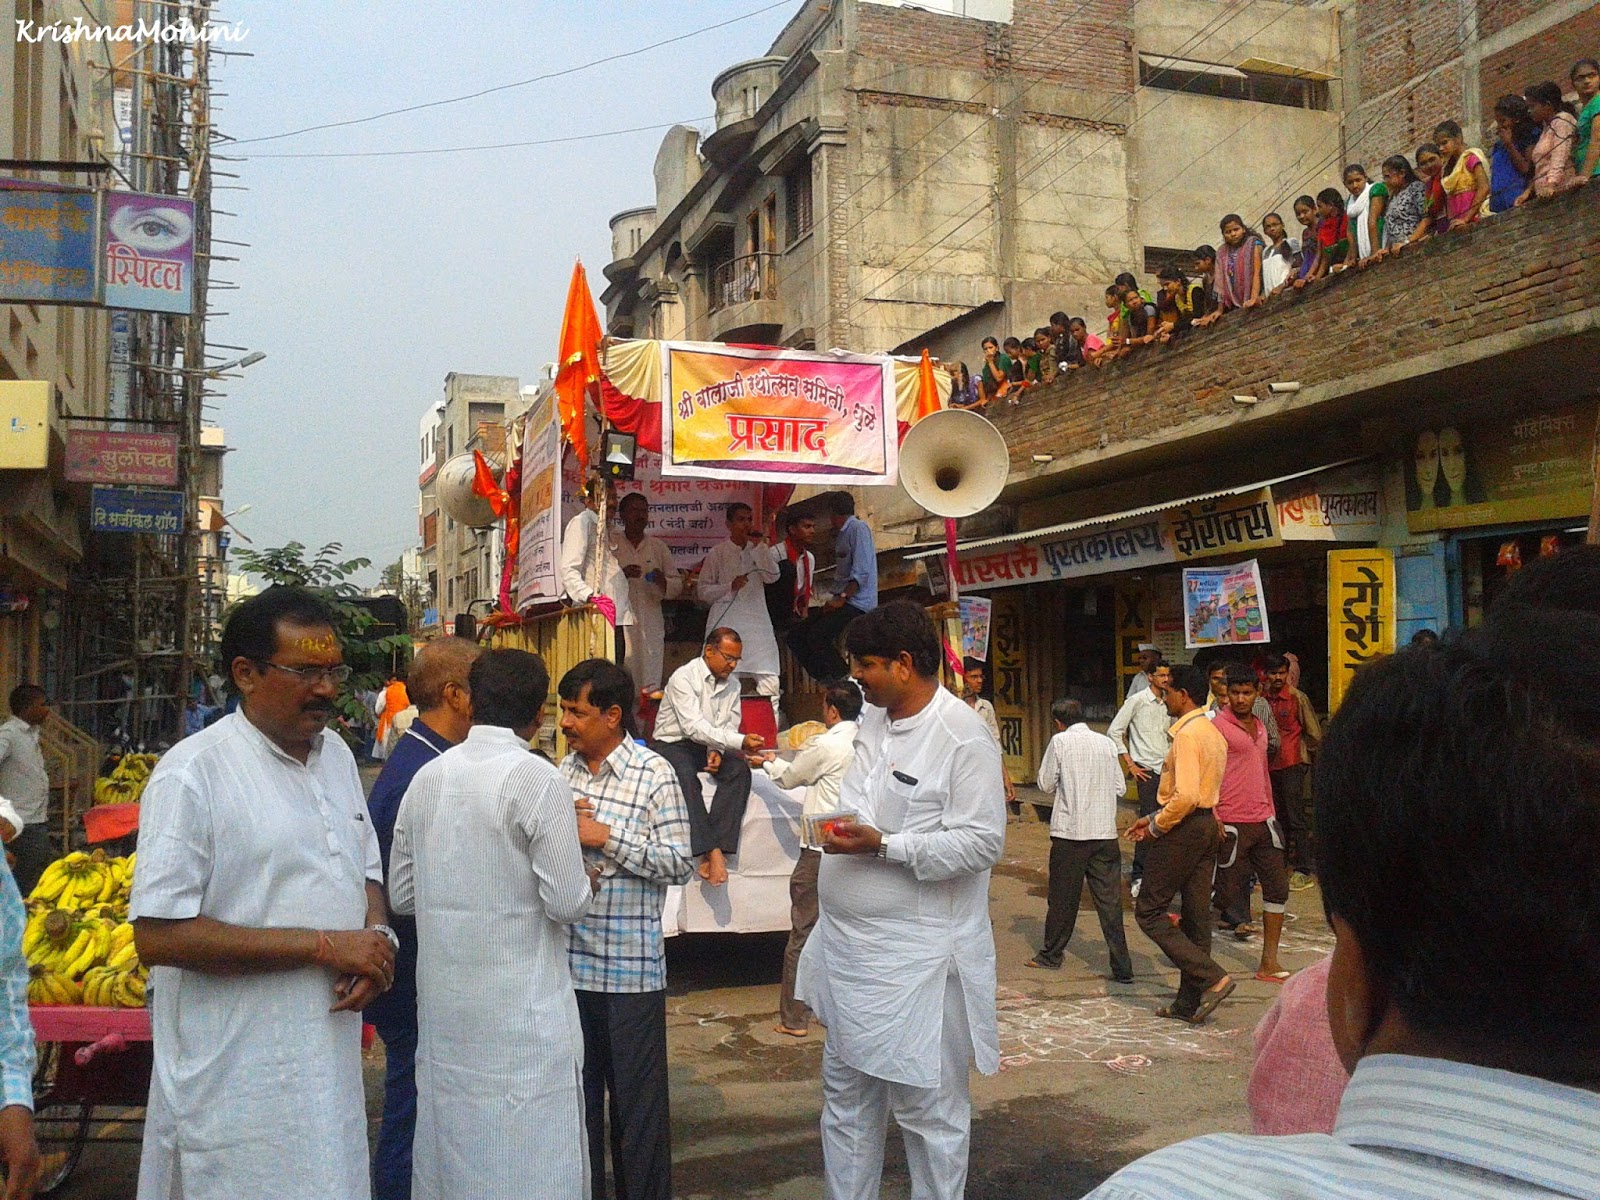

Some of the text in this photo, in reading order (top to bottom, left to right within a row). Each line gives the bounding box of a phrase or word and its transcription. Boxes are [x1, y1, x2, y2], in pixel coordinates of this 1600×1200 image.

[106, 243, 183, 291] स्पिटल
[678, 391, 694, 420] श्री
[695, 371, 745, 409] बालाजी
[802, 376, 848, 418] समिती,
[725, 413, 829, 458] प्रसाद
[648, 500, 702, 513] तनलालजी
[1171, 501, 1273, 556] झेरॉक्स
